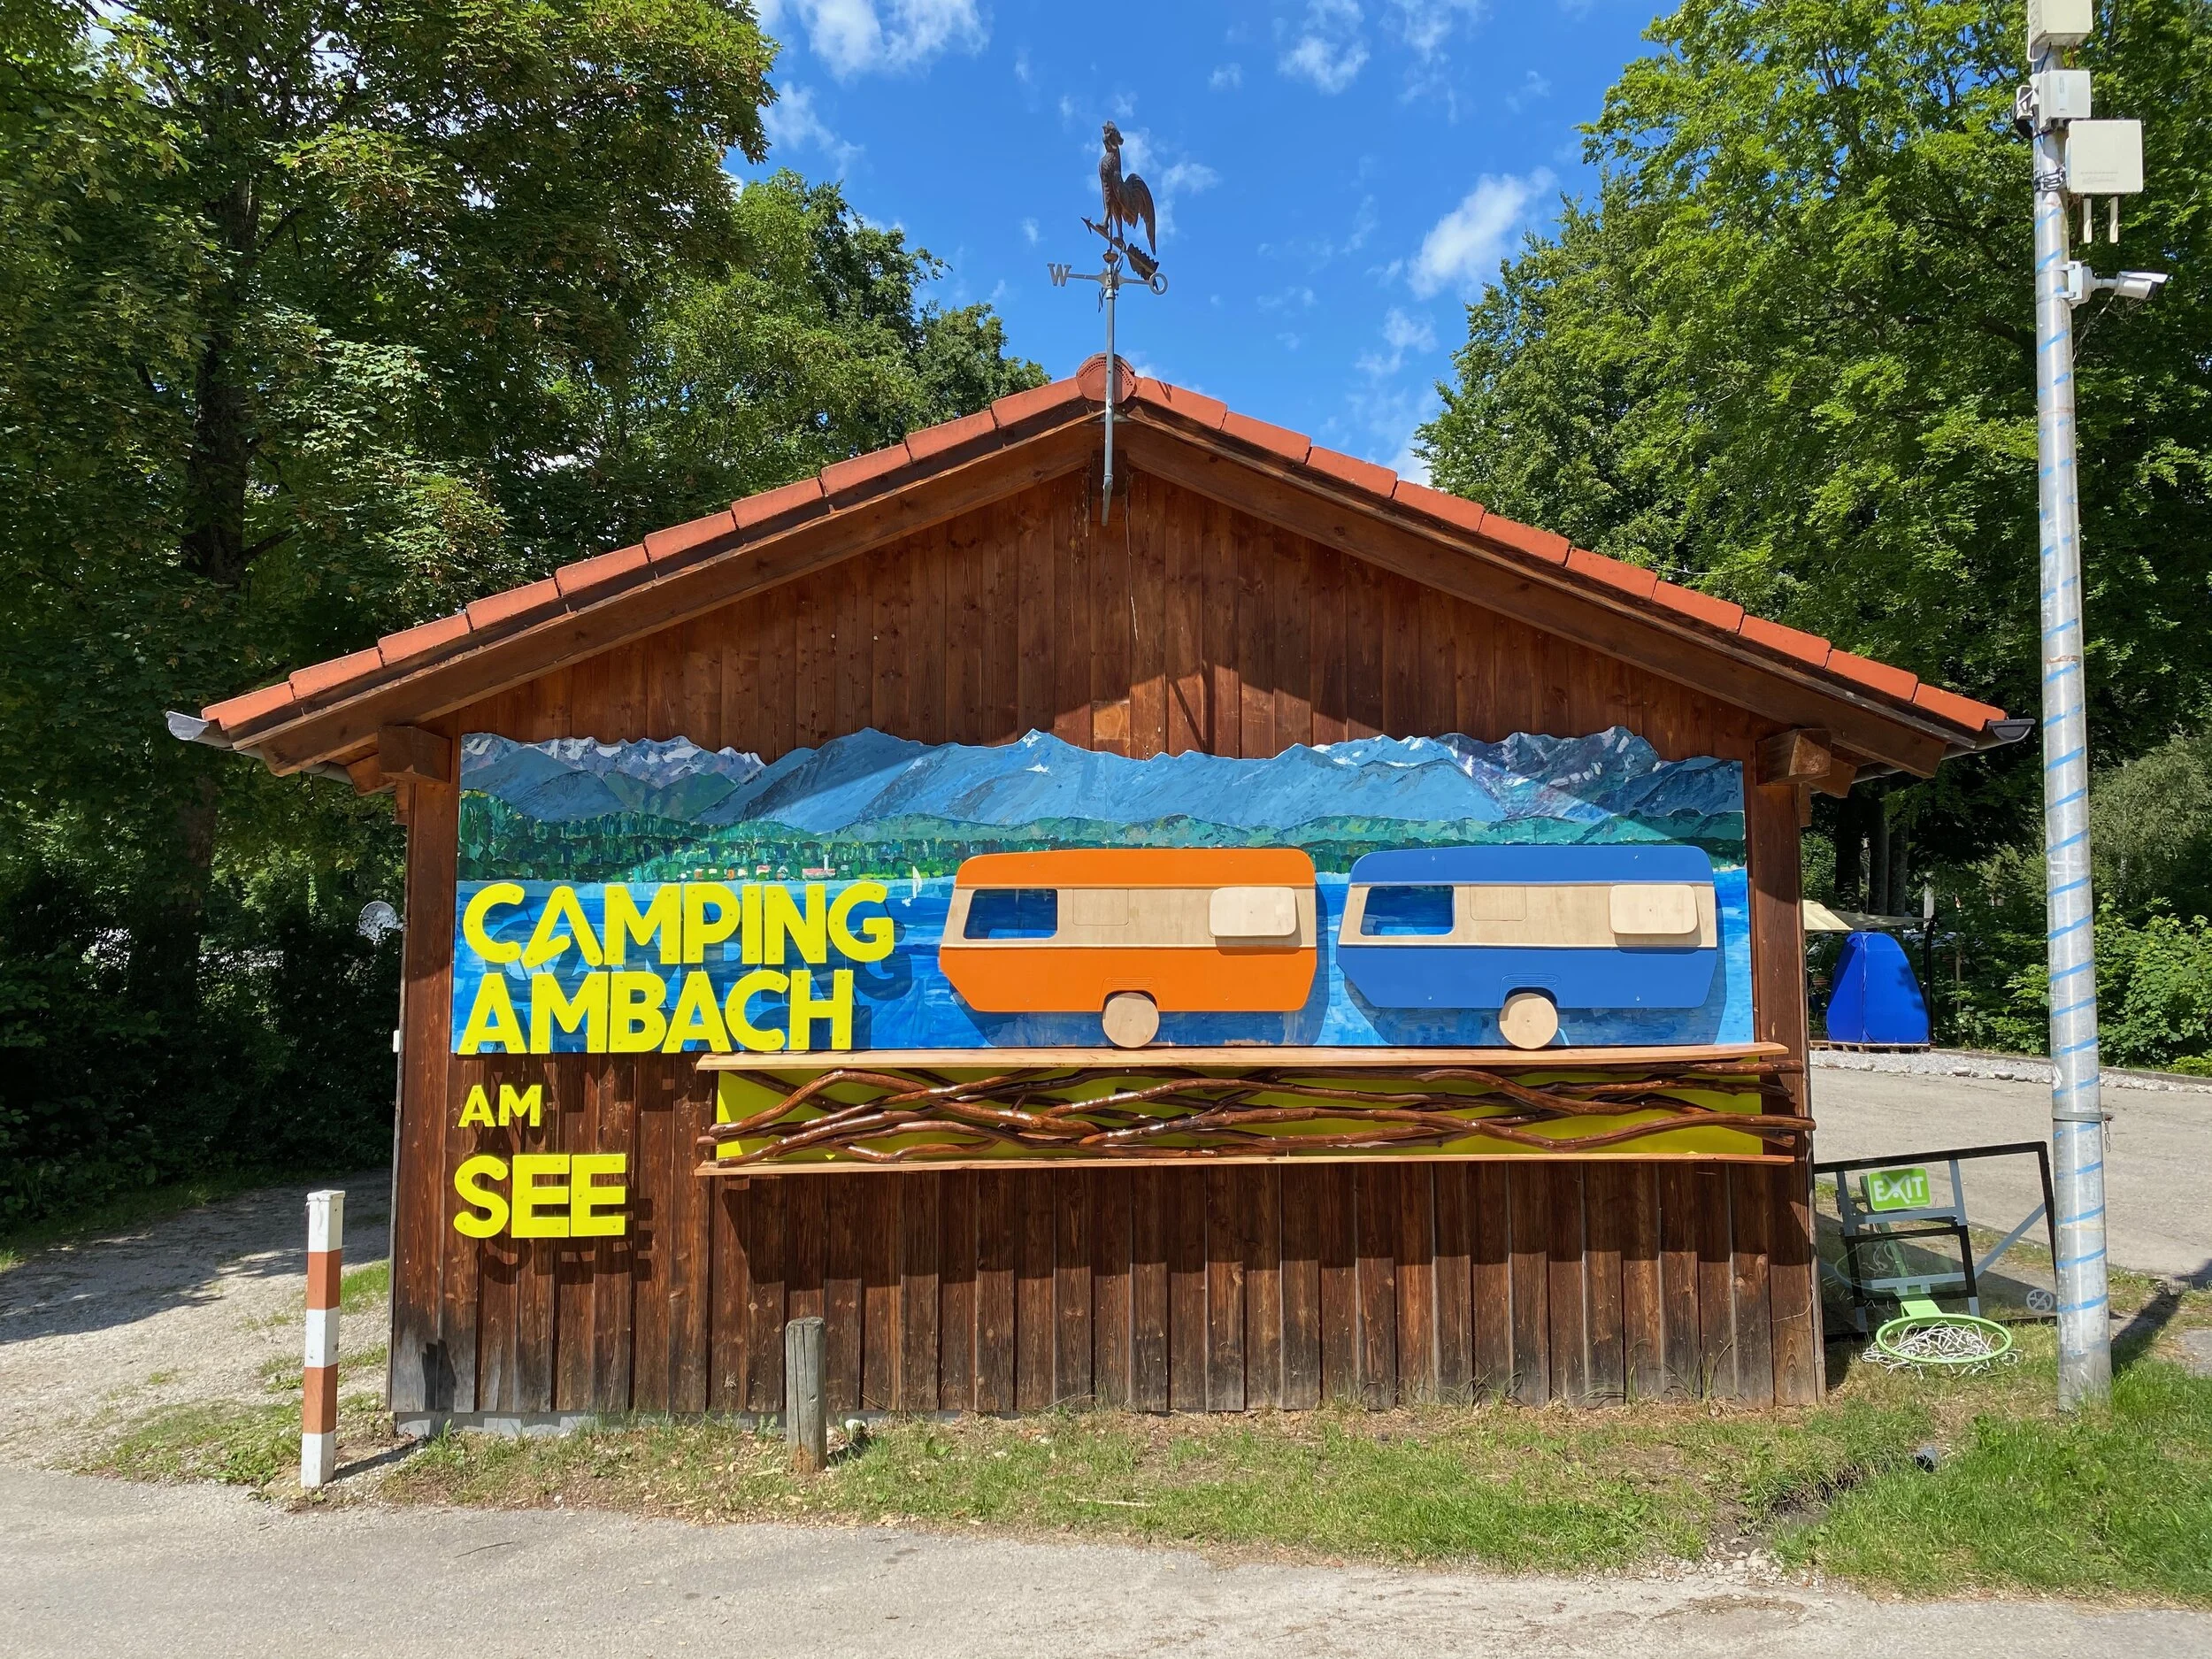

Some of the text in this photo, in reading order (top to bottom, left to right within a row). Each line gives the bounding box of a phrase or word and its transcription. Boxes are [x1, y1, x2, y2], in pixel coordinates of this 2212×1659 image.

[1047, 263, 1071, 287] W
[463, 882, 894, 968] CAMPING
[457, 970, 854, 1055] AMBACH
[458, 1085, 542, 1127] AM
[453, 1154, 626, 1239] SEE
[1873, 1174, 1924, 1204] EXIT
